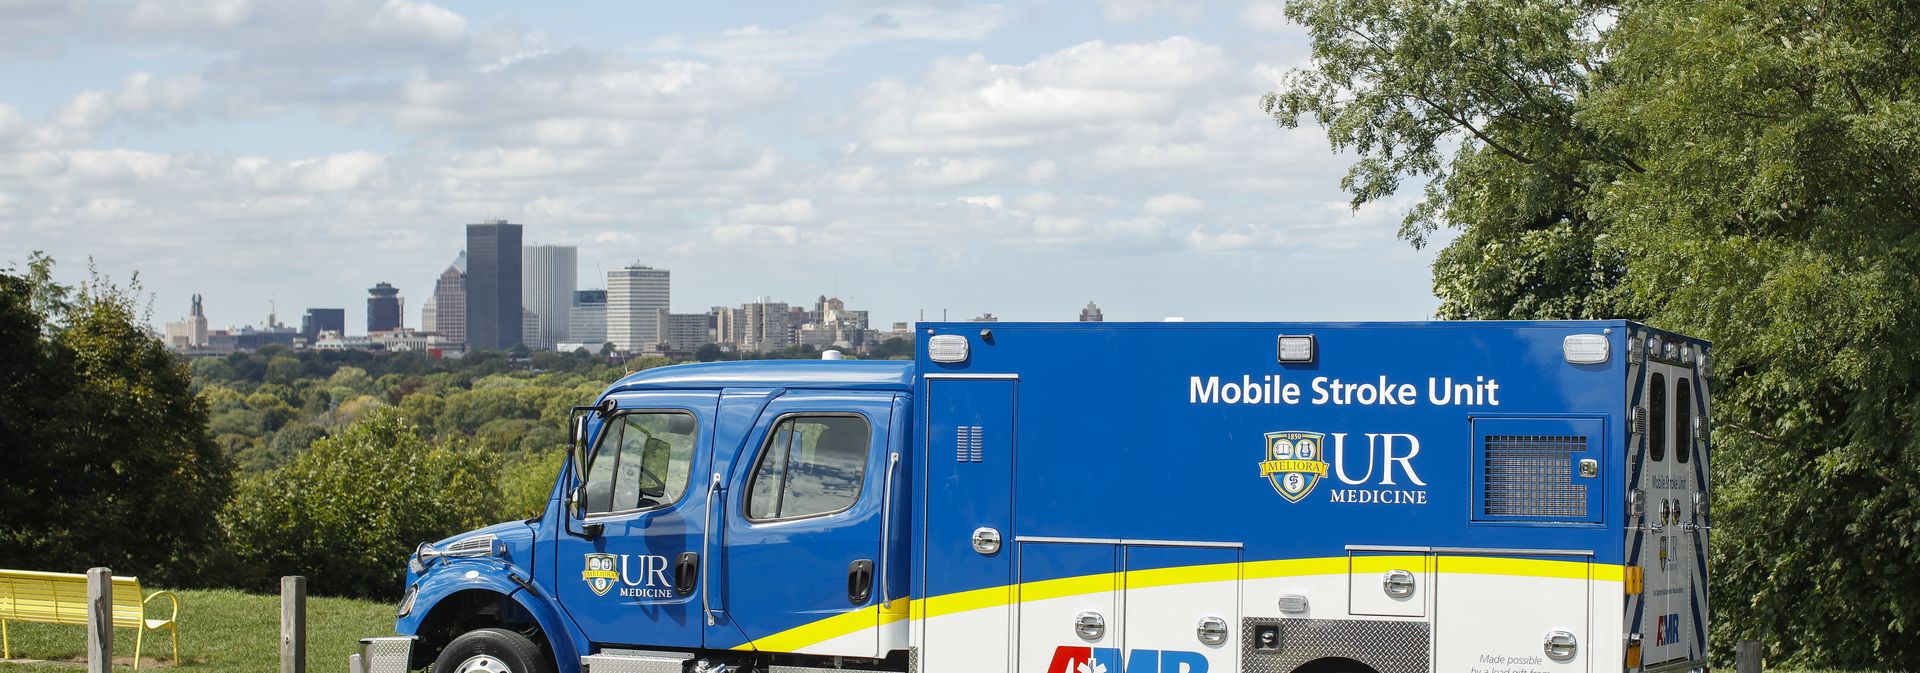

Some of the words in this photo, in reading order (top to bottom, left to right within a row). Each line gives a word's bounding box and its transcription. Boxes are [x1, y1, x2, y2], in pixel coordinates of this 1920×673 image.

[1190, 375, 1301, 404] Mobile
[1311, 376, 1417, 405] Stroke
[1428, 376, 1500, 405] Unit
[1268, 462, 1320, 471] MELIORA
[1331, 433, 1427, 486] UR
[1330, 489, 1427, 504] MEDICINE
[620, 554, 672, 587] UR
[620, 587, 673, 598] MEDICINE
[1480, 654, 1505, 664] Made
[1507, 655, 1542, 666] possible
